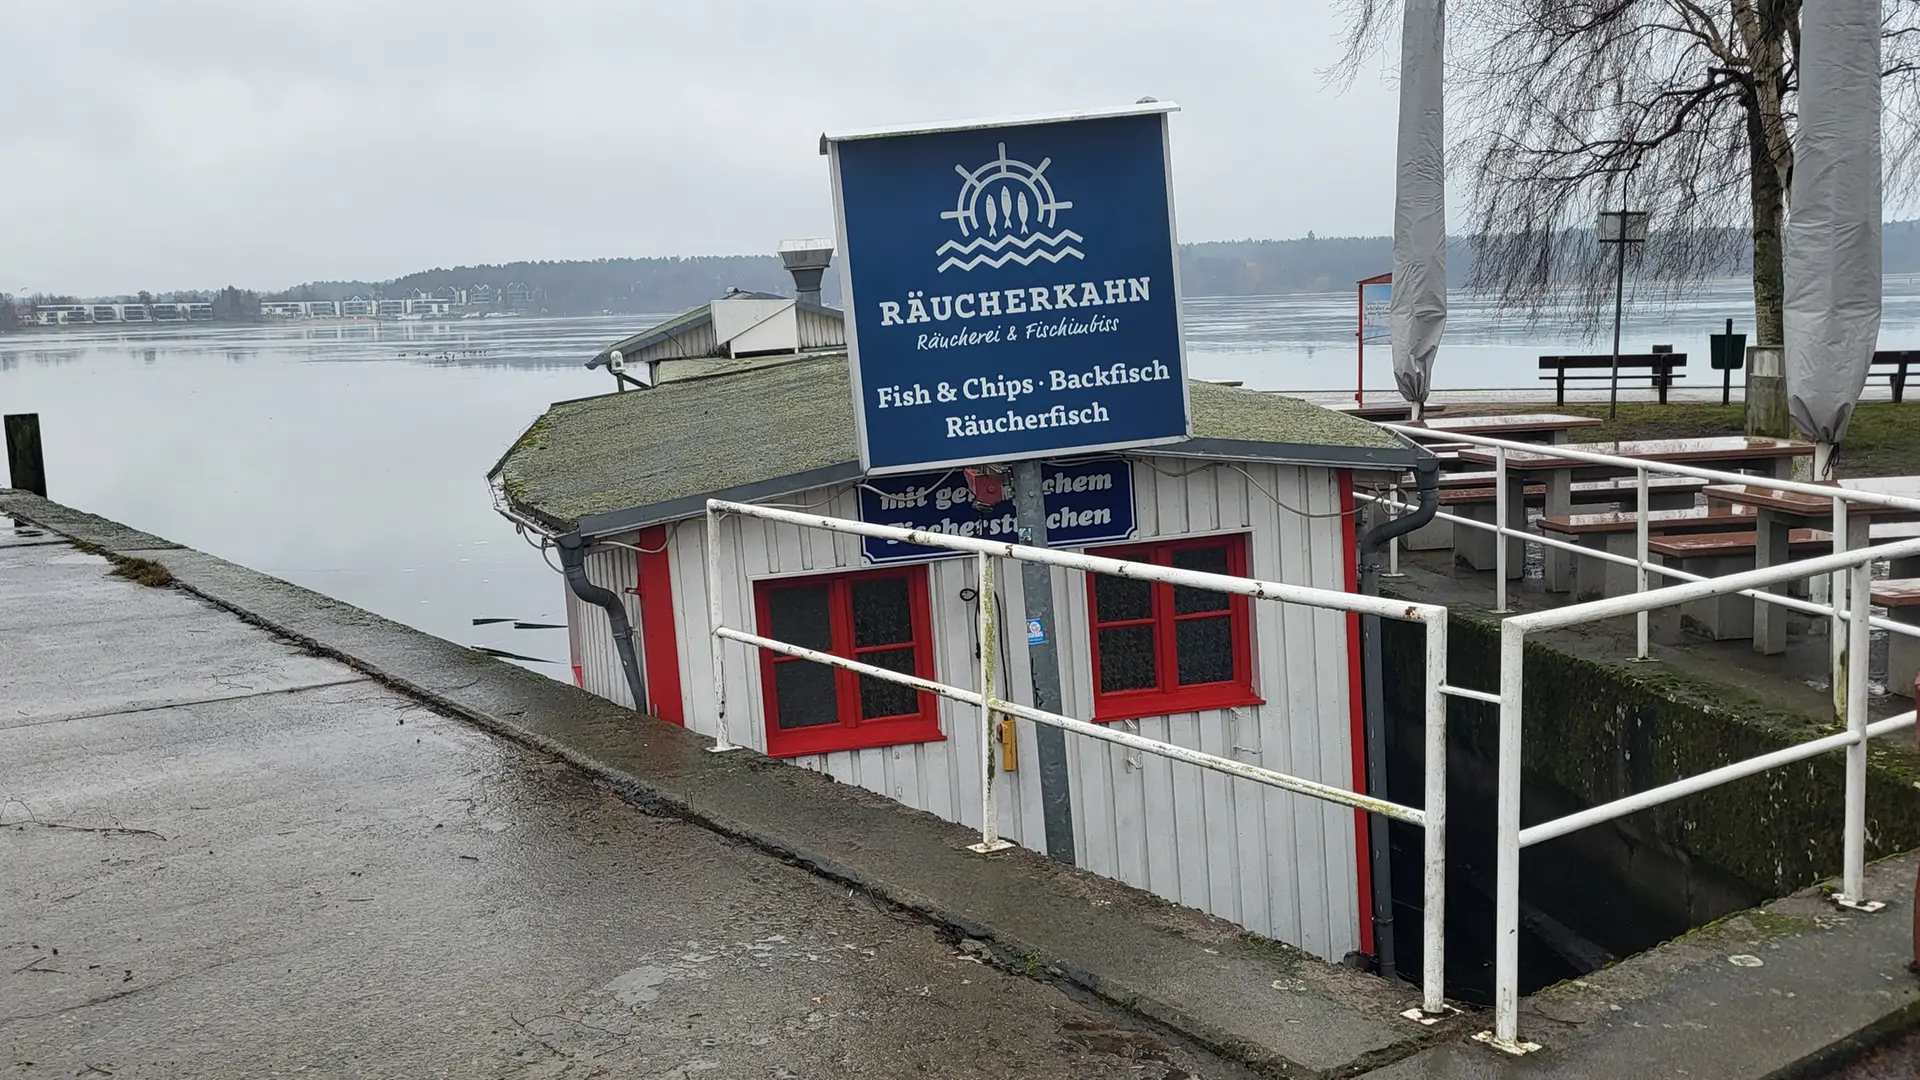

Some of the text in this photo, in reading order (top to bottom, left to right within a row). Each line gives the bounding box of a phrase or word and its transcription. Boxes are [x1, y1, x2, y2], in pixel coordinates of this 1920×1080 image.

[880, 277, 1150, 326] RÄUCHERKAHN
[917, 314, 1120, 350] Räucherei & Fischimbiss
[877, 384, 931, 408] Fish
[937, 382, 958, 402] &
[963, 375, 1034, 402] Chips
[1049, 360, 1170, 391] Backfisch
[946, 402, 1109, 438] Räucherfisch
[880, 472, 1112, 510] mit gechem
